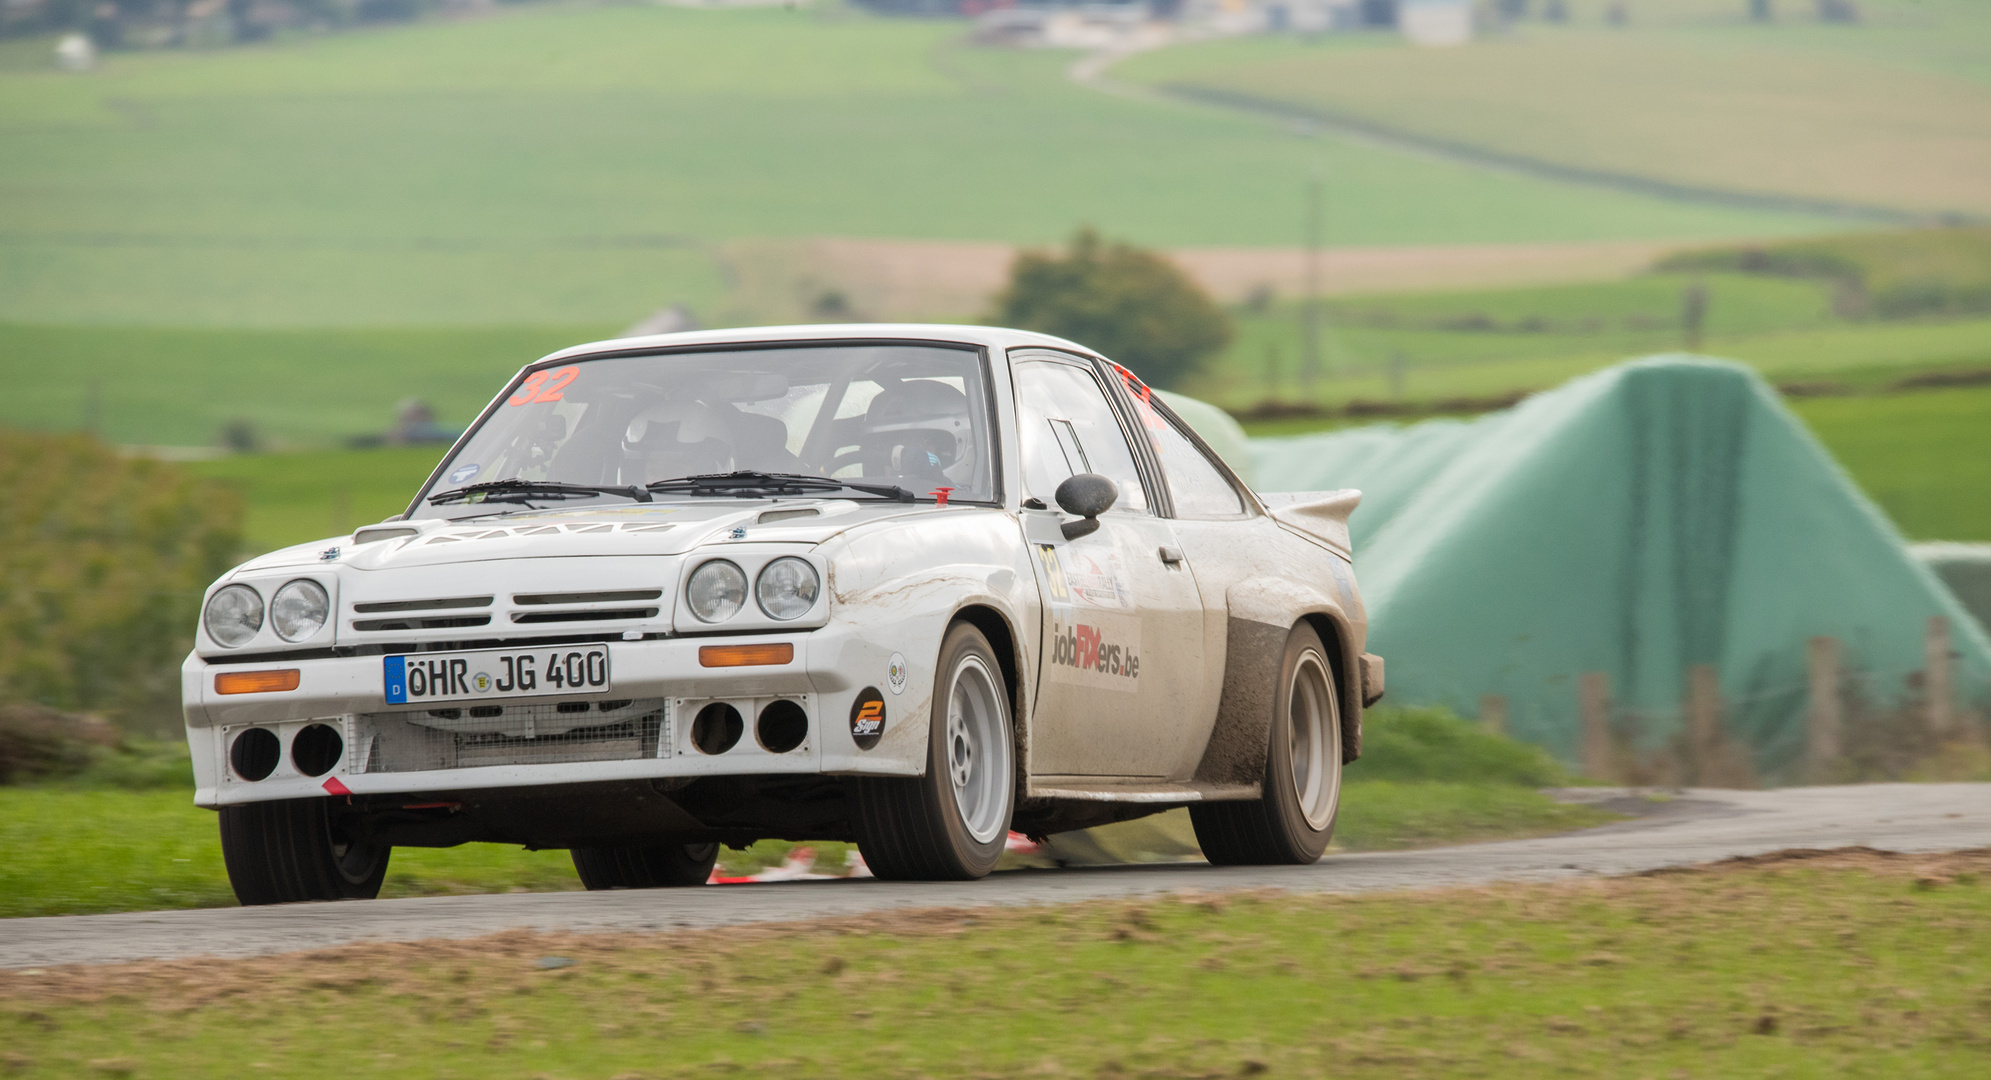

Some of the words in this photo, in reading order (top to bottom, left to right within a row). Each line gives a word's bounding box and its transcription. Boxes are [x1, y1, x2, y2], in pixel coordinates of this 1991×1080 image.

[508, 366, 580, 407] 32
[1038, 547, 1068, 598] 32
[1052, 623, 1139, 678] jobFIXers.be
[392, 684, 400, 695] D
[407, 659, 469, 696] ÖHR
[496, 655, 536, 692] JG
[546, 651, 605, 689] 400
[853, 718, 880, 735] Sign
